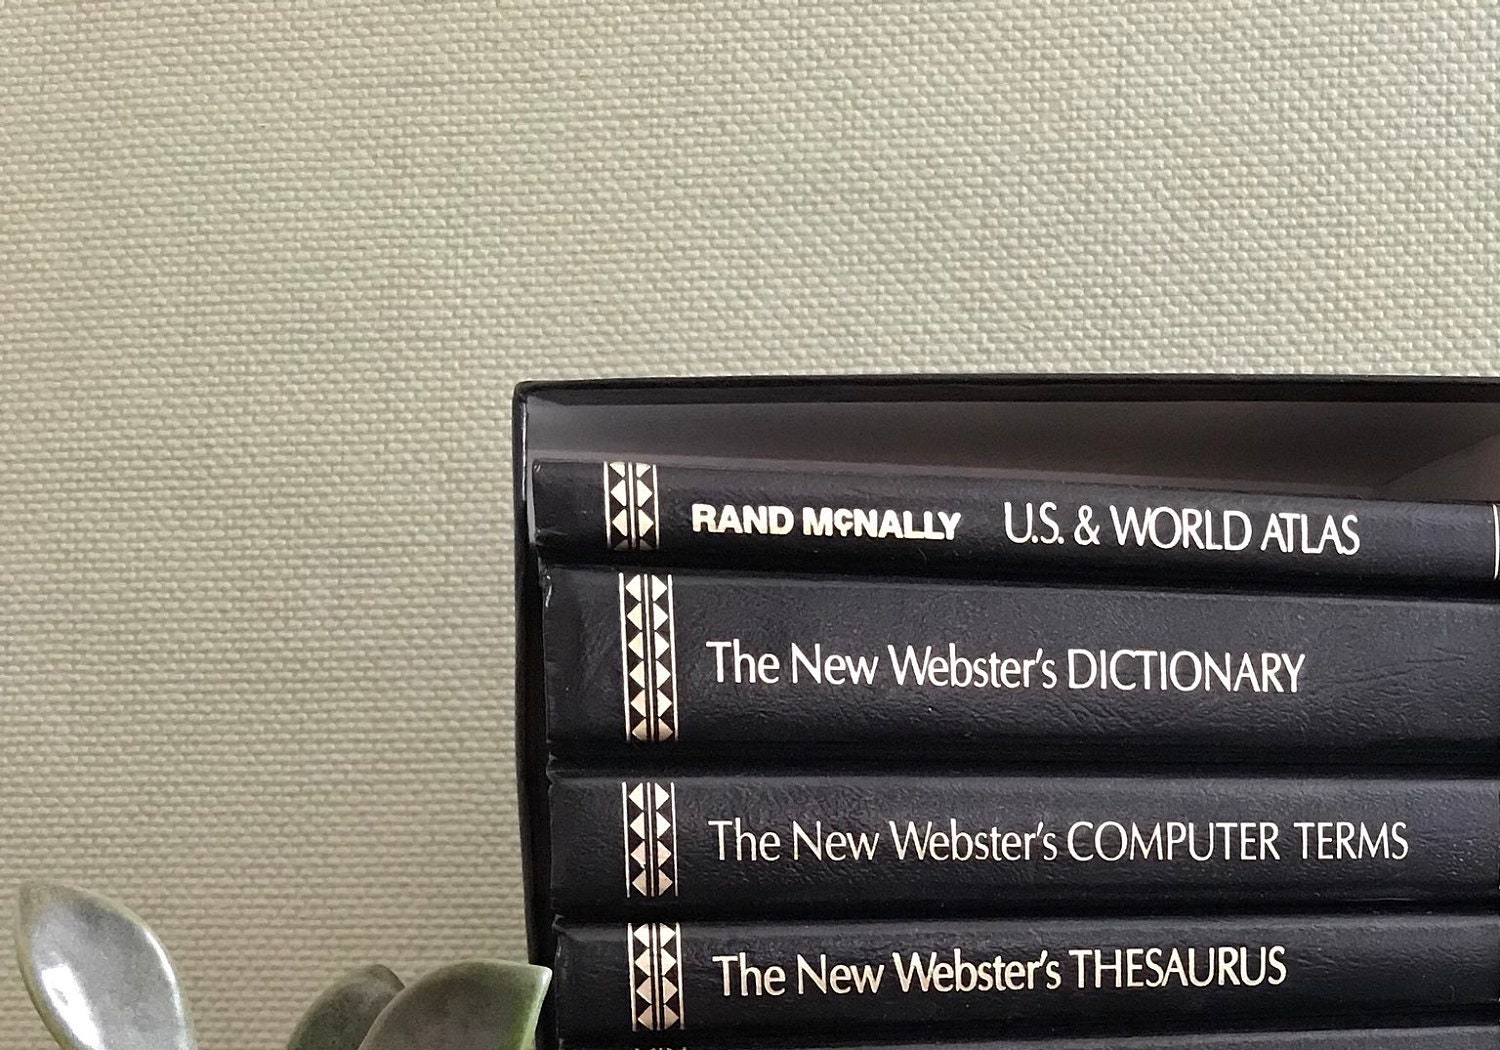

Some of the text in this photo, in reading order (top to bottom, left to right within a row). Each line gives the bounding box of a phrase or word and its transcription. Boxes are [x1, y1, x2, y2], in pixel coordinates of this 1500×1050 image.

[691, 502, 795, 535] RAND
[1003, 501, 1066, 545] U.S.
[1073, 504, 1101, 547] &
[1108, 504, 1253, 551] WORLD
[1260, 509, 1361, 556] ATLAS
[705, 638, 1306, 694] The New Webster's DICTIONARY
[707, 816, 1410, 862] The New Webster's COMPUTER TERMS
[711, 945, 1287, 998] The New Webster's THESAURUS
